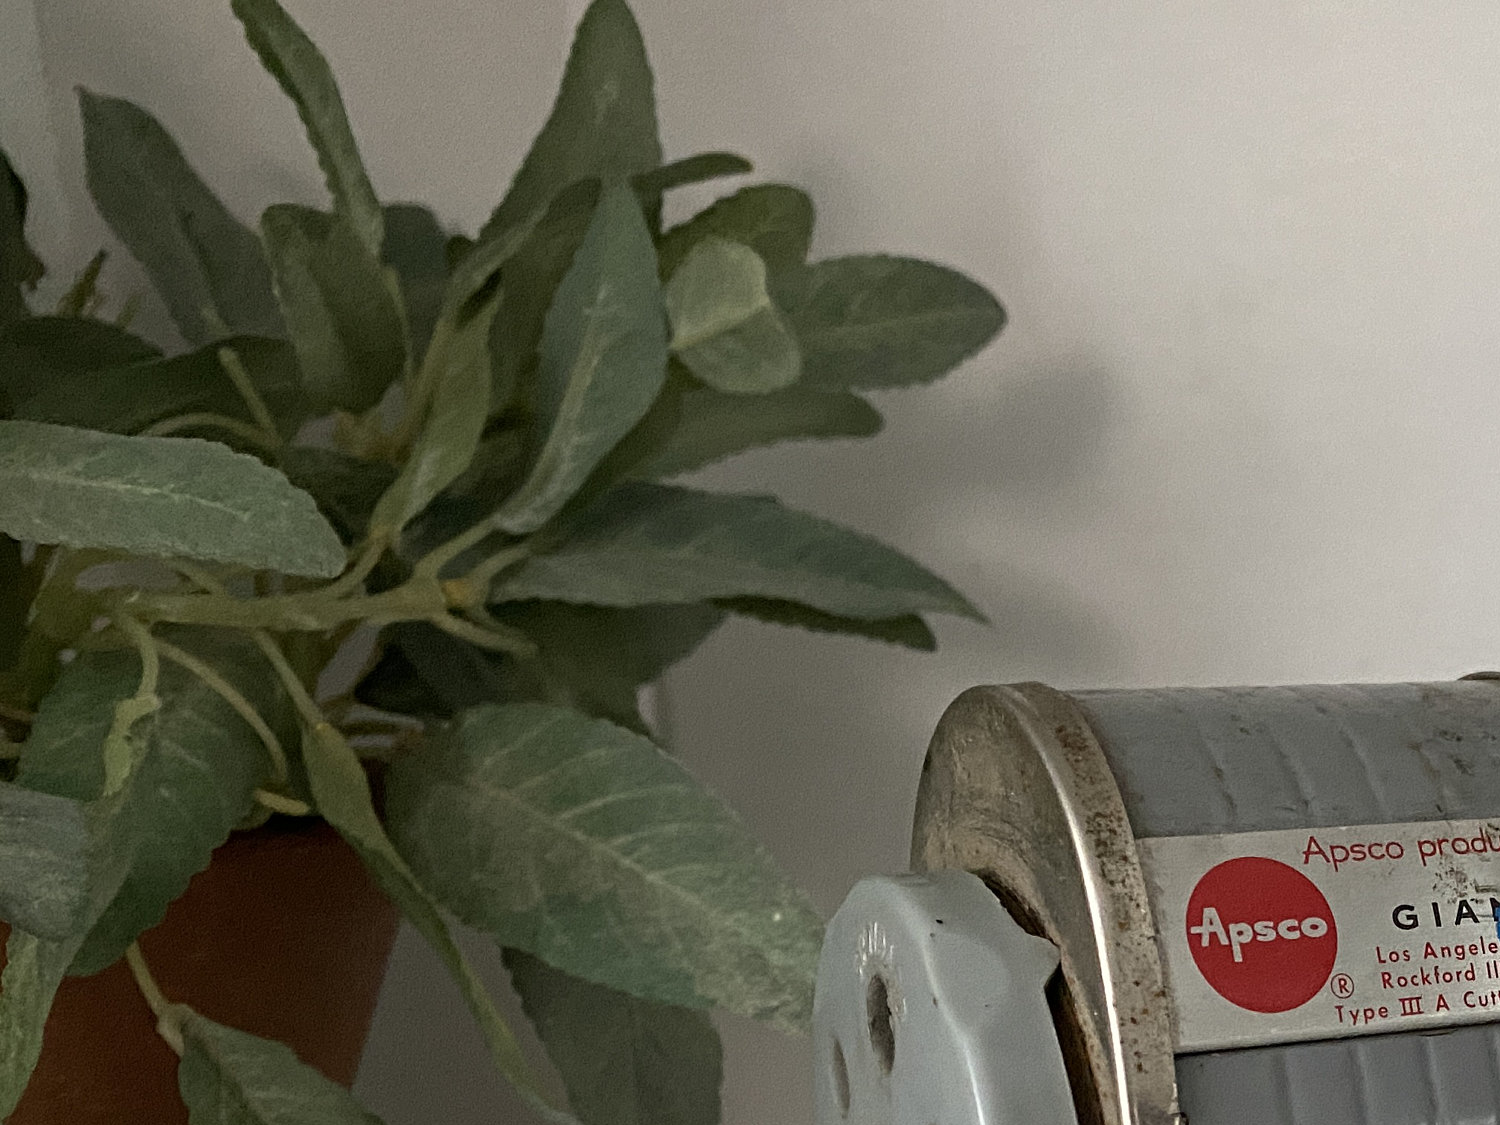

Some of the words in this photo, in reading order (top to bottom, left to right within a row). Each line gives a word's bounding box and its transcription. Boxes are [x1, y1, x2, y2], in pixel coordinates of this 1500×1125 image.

[1302, 835, 1405, 872] Apsco
[1190, 906, 1329, 963] Apsco
[1376, 946, 1411, 964] Los
[1382, 960, 1477, 990] Rockford
[1335, 1005, 1389, 1027] Type
[1399, 997, 1424, 1016] III
[1436, 995, 1450, 1012] A
